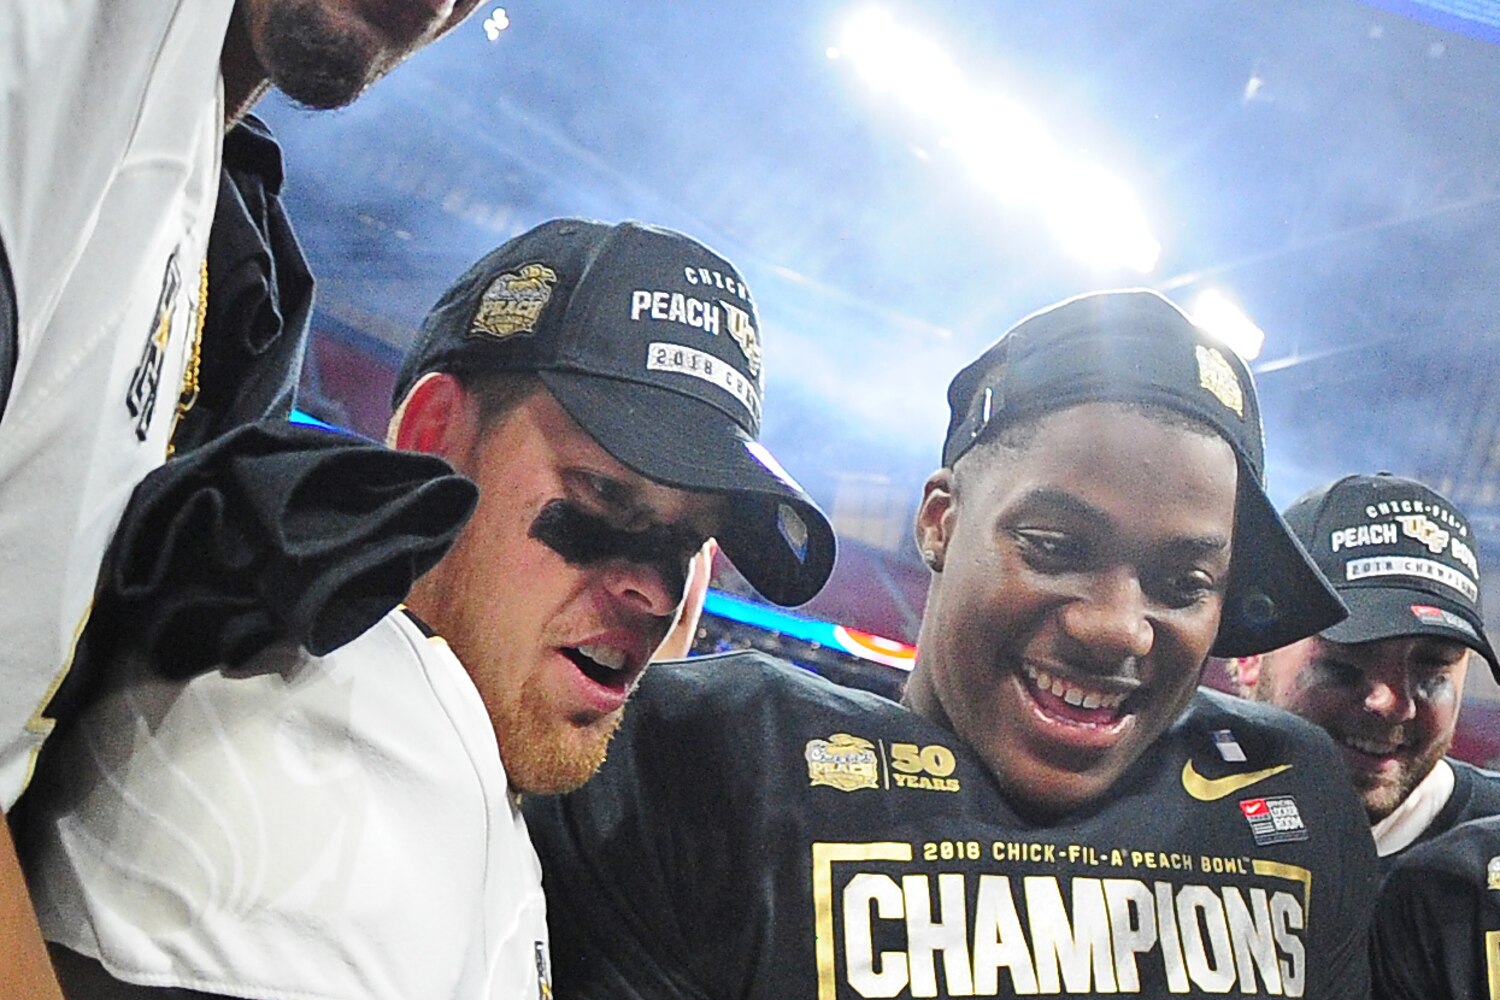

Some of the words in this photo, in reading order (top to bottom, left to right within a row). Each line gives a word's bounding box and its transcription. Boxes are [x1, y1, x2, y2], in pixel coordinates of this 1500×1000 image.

[630, 290, 720, 336] PEACH
[655, 348, 713, 375] 2018
[1331, 523, 1398, 552] PEACH
[1394, 514, 1450, 554] UCF
[890, 742, 957, 778] 50
[892, 772, 961, 793] YEARS
[923, 841, 981, 862] 2018
[992, 842, 1124, 866] CHICK-FIL-A
[1131, 851, 1193, 870] PEACH
[1200, 856, 1248, 875] BOWL
[843, 872, 1306, 998] CHAMPIONS
